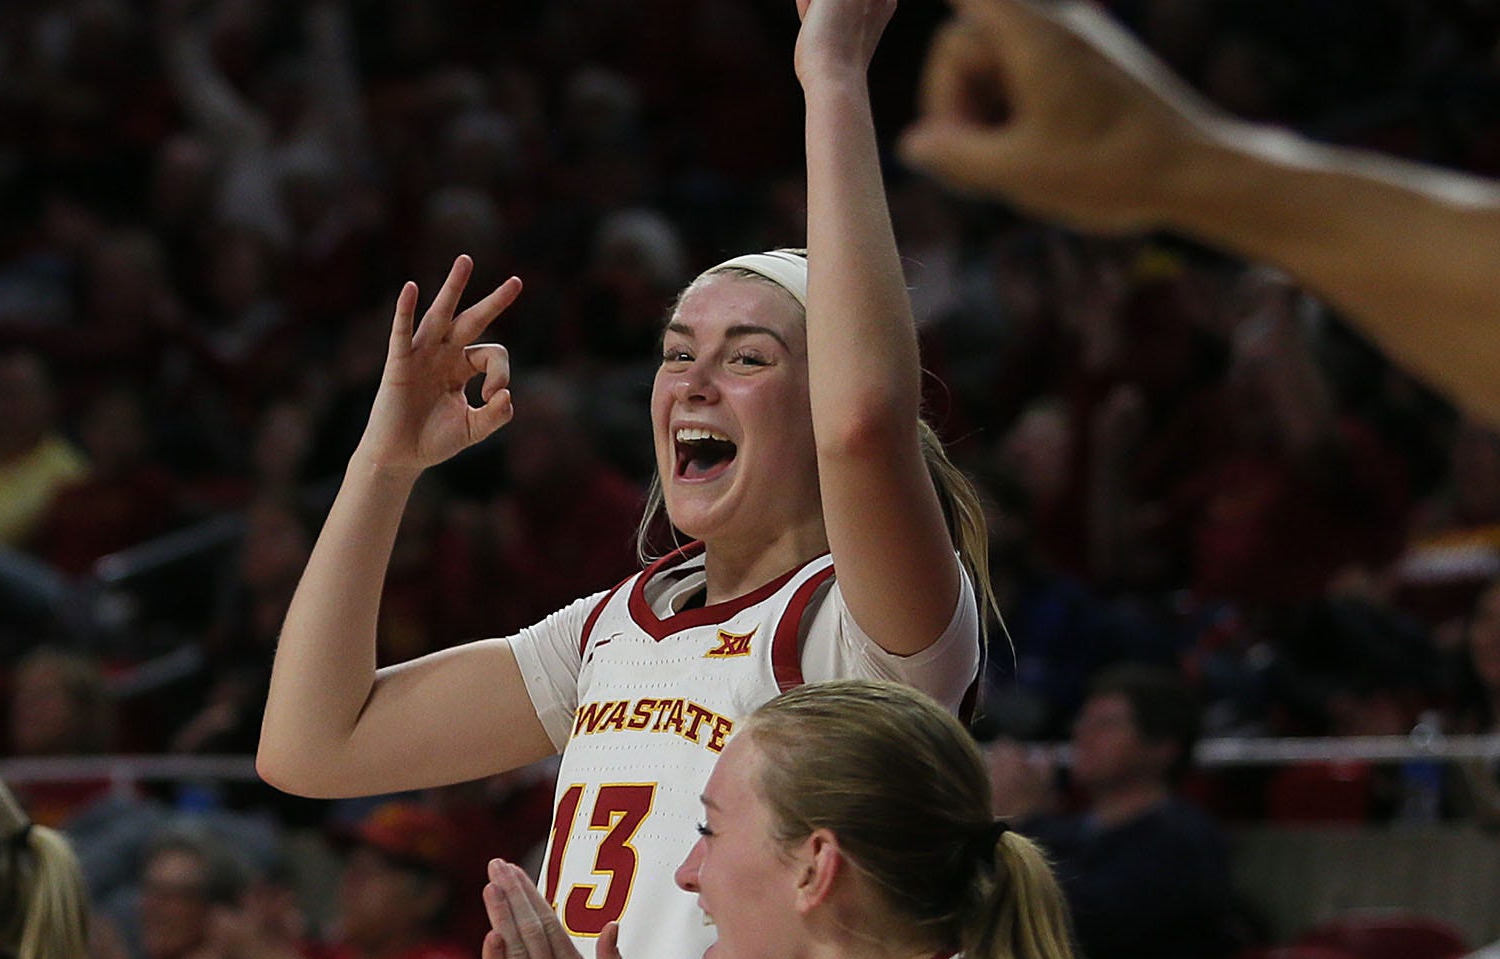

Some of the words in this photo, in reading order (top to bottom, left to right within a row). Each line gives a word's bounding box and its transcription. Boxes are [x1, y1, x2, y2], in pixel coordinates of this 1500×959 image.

[573, 700, 632, 740] WA
[627, 698, 736, 754] STATE
[545, 783, 658, 936] 13
